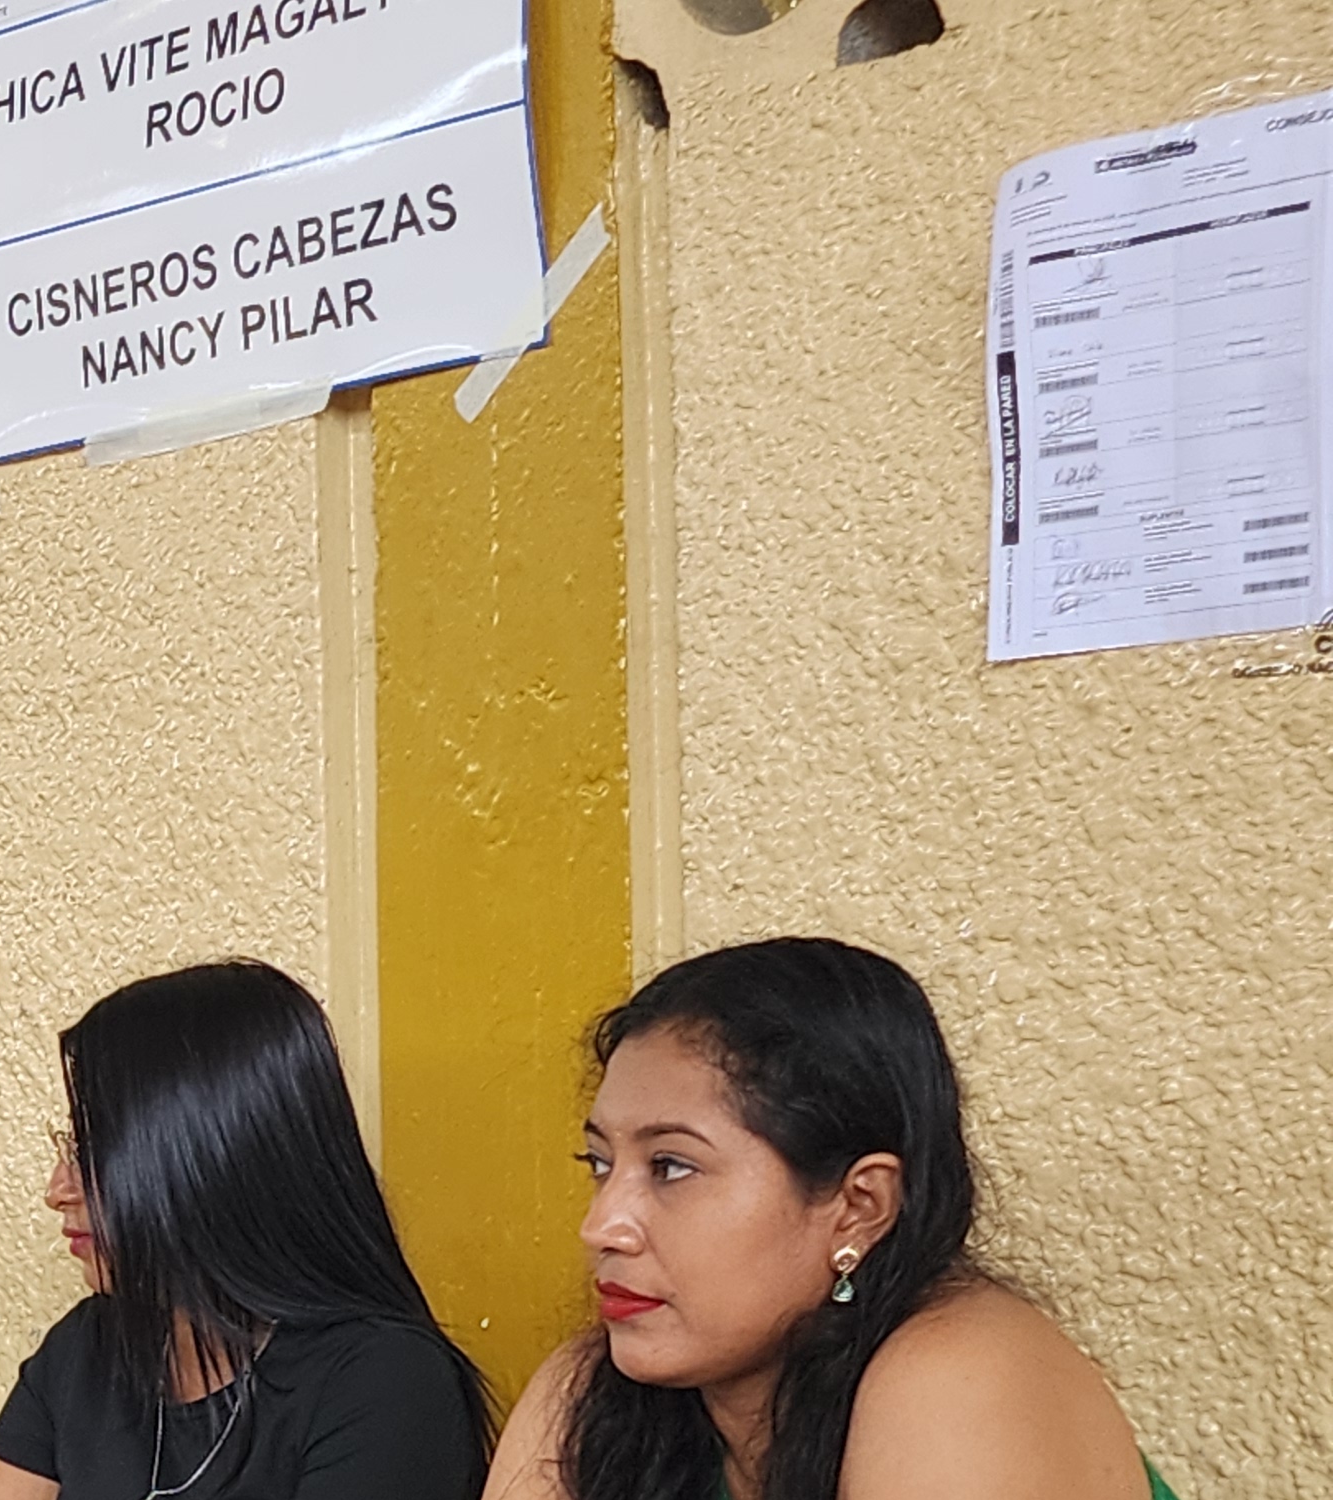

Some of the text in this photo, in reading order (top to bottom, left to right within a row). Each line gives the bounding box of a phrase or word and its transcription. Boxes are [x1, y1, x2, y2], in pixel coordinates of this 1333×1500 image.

[100, 26, 191, 93] VITE
[145, 68, 285, 148] ROCIO
[7, 182, 459, 337] CISNEROS CABEZAS
[80, 277, 378, 388] NANCY PILAR
[1004, 461, 1016, 523] COLOCAR
